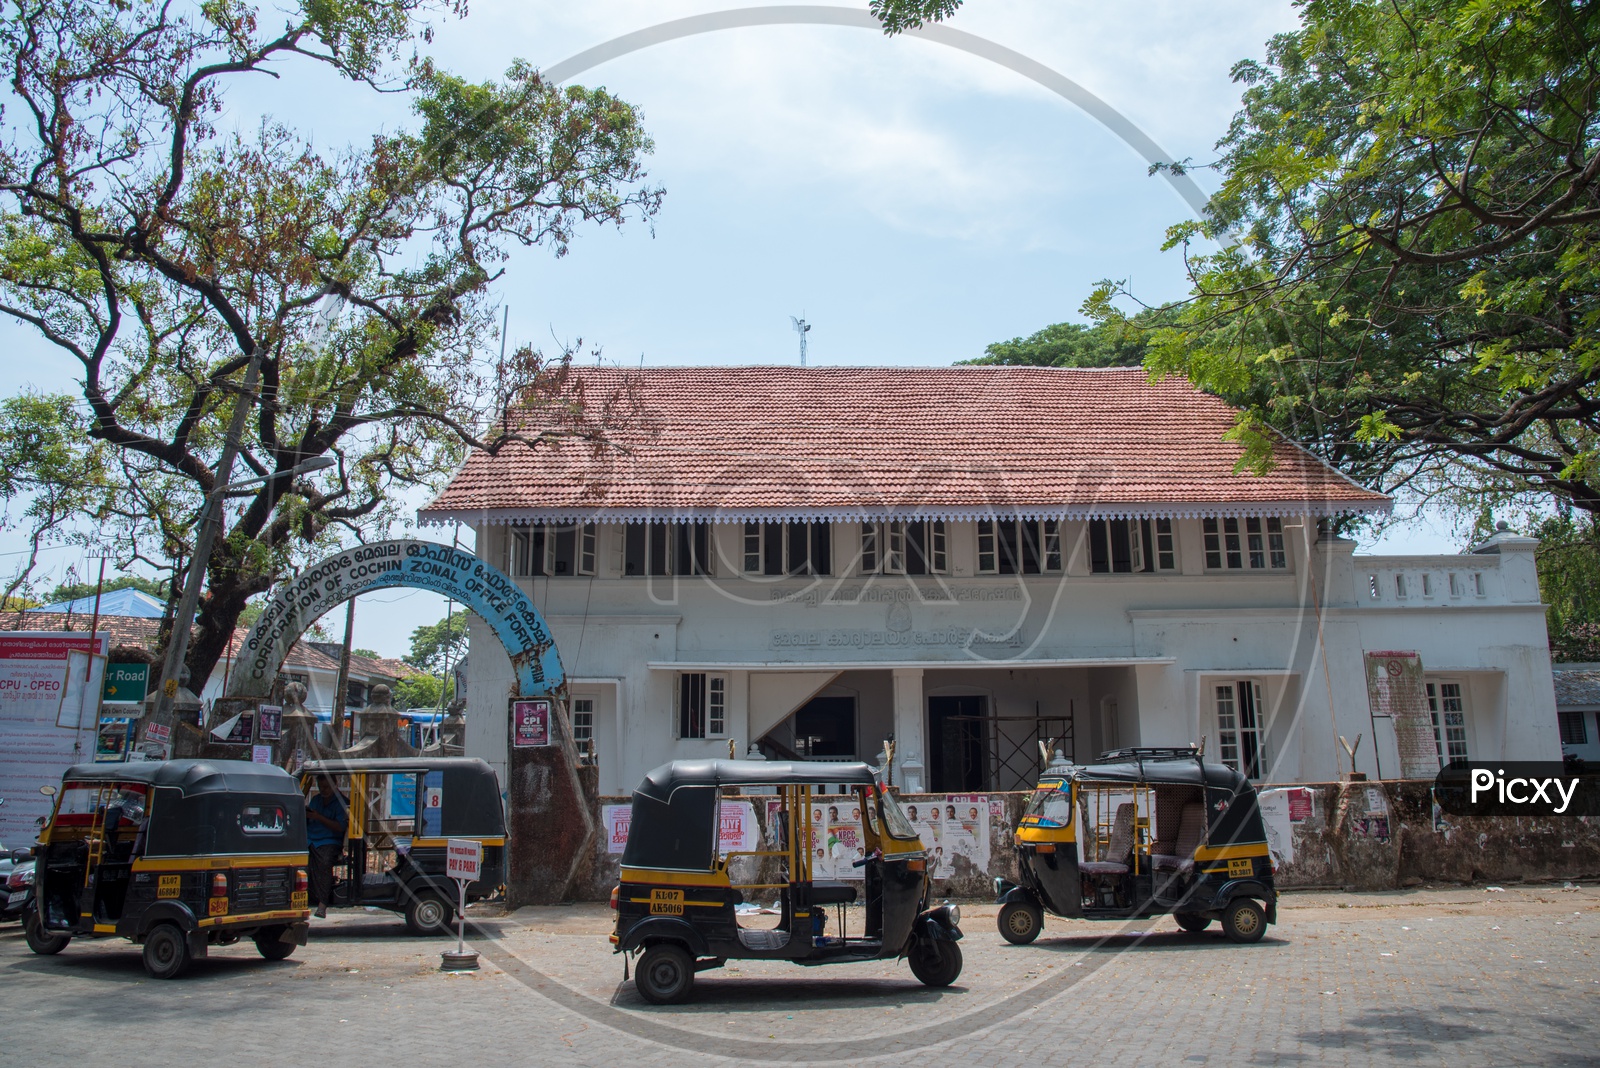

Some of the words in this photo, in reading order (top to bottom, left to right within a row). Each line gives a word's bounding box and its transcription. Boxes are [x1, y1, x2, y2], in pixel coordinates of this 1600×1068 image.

[285, 555, 352, 602] നഗരസഭ
[354, 543, 401, 563] മേഖല
[252, 588, 322, 680] CORPORATION
[325, 574, 343, 592] OF
[349, 559, 402, 580] COCHIN
[410, 559, 459, 583] ZONAL
[465, 578, 508, 614] OFFICE
[116, 669, 145, 681] Road
[30, 680, 60, 691] CPEO
[122, 708, 142, 718] Country
[523, 717, 540, 725] CPI
[431, 795, 439, 807] 8
[463, 860, 477, 873] PARK
[651, 903, 682, 914] AK5016
